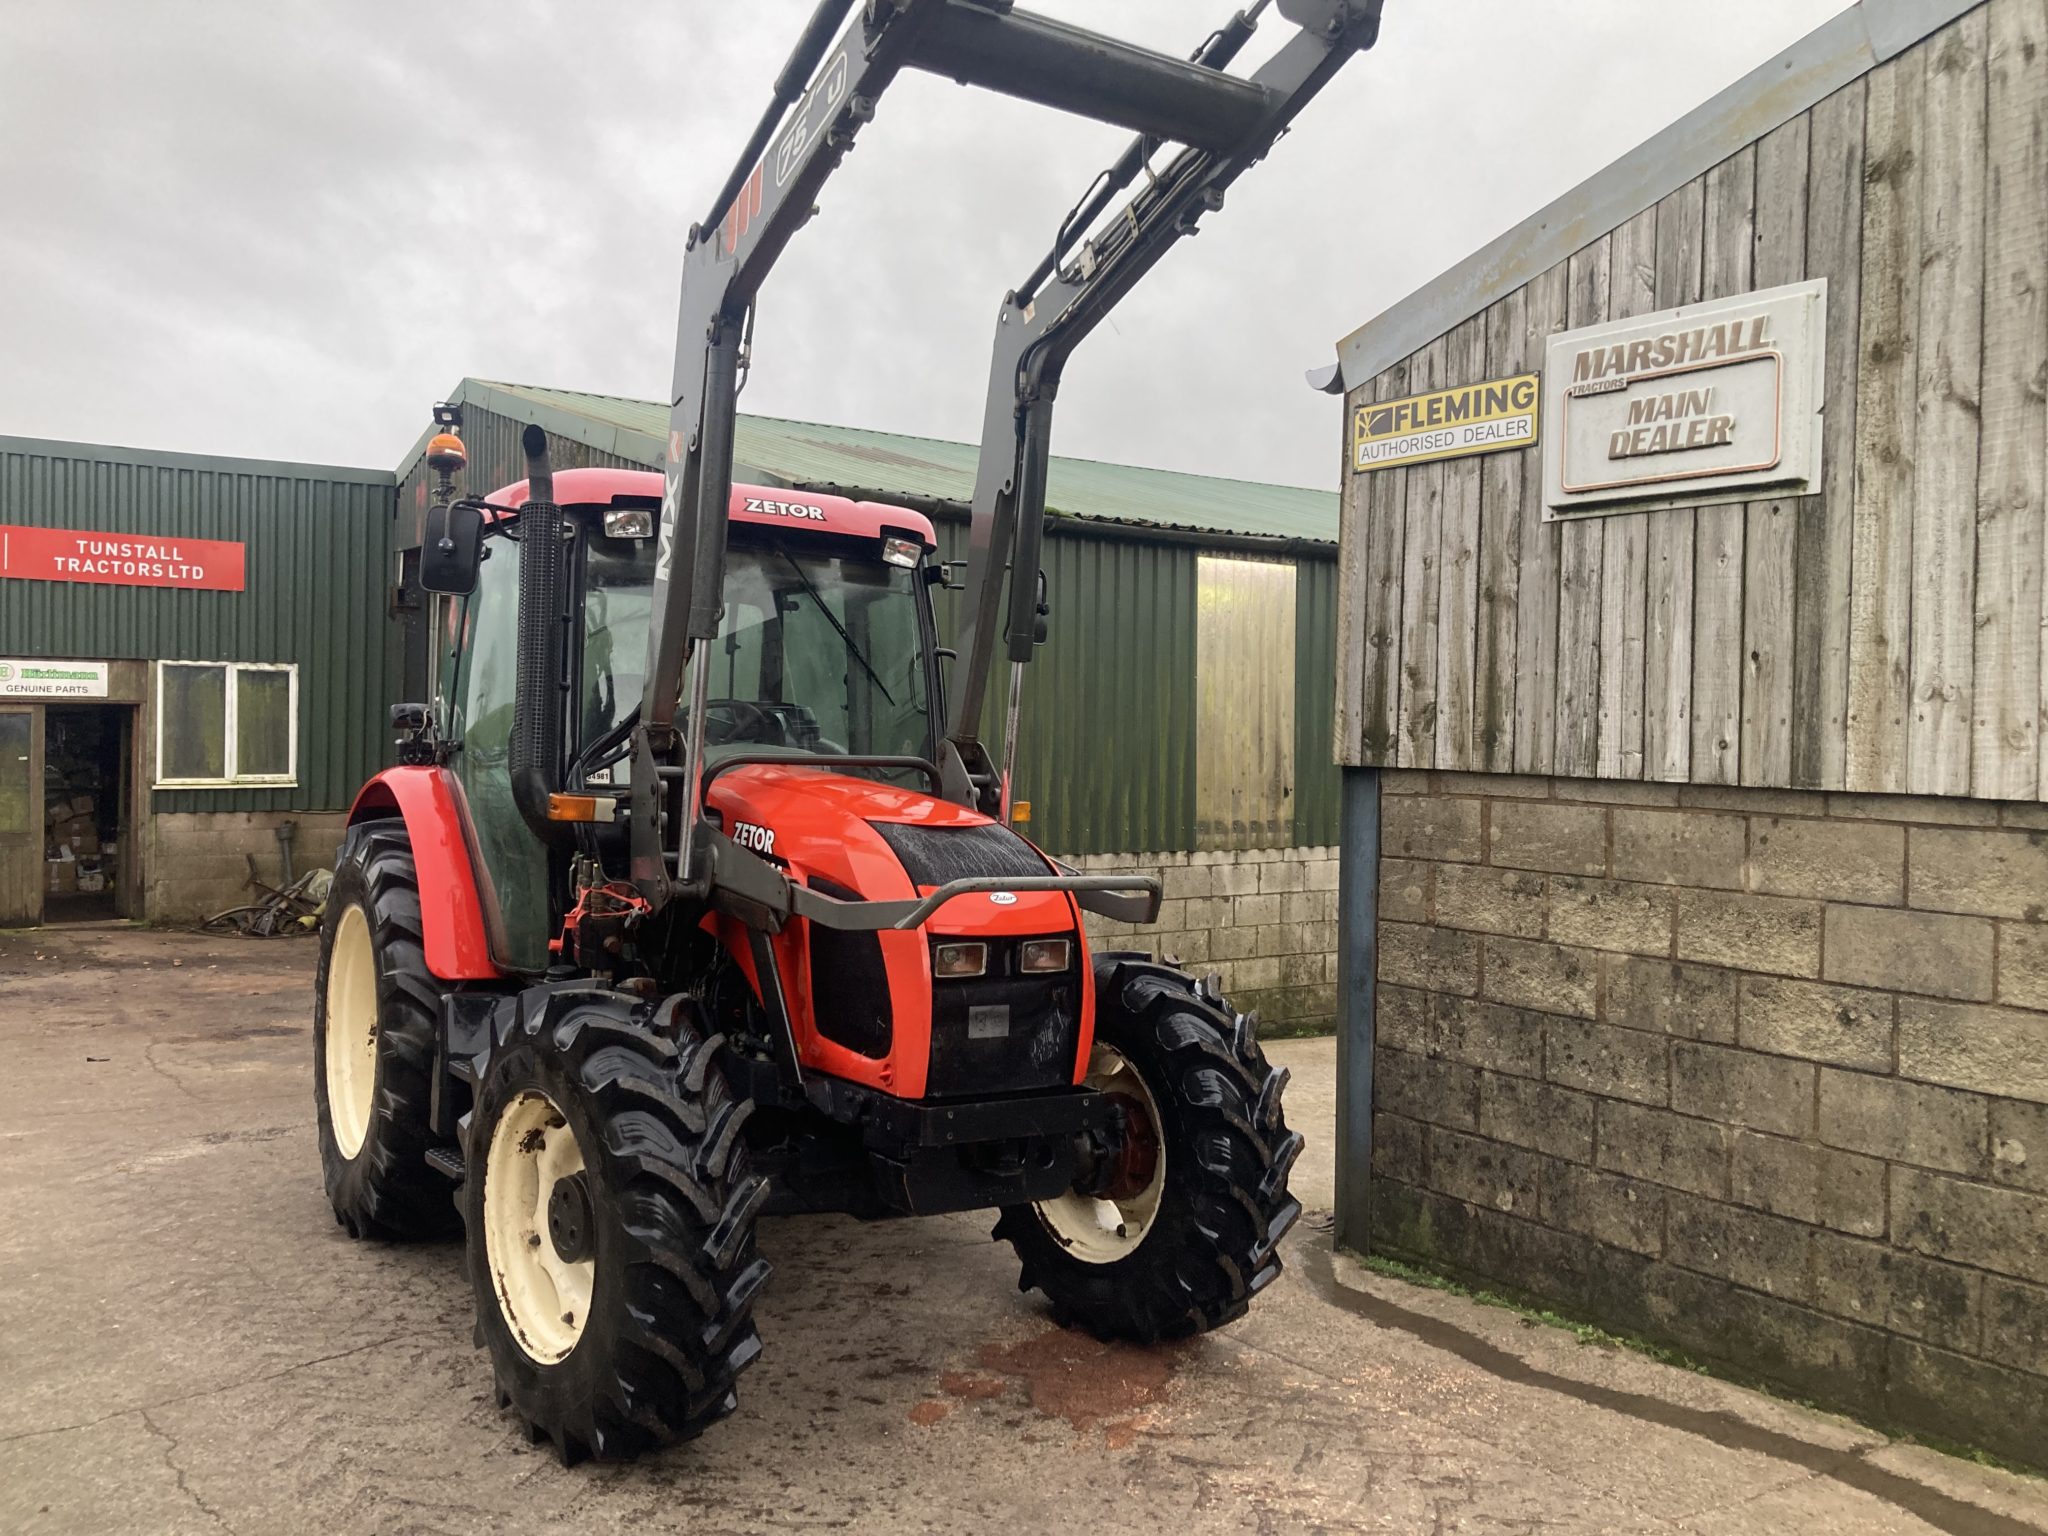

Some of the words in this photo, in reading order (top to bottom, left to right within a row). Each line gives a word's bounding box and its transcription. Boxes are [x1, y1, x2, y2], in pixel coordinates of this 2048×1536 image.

[1573, 315, 1772, 384] MARSHALL
[1572, 377, 1625, 396] TRACTORS
[1394, 380, 1535, 433] FLEMING
[1627, 387, 1711, 426] MAIN
[1361, 431, 1455, 461] AUTHORISED
[1463, 419, 1529, 443] DEALER
[1608, 415, 1735, 459] DEALER
[656, 471, 679, 581] MX
[745, 498, 825, 521] ZETOR
[54, 557, 163, 577] TRACTORS
[168, 563, 204, 580] LTD
[76, 540, 184, 561] TUNSTALL
[6, 684, 53, 693] GENUINE
[55, 685, 89, 694] PARTS
[732, 821, 775, 855] ZETOR
